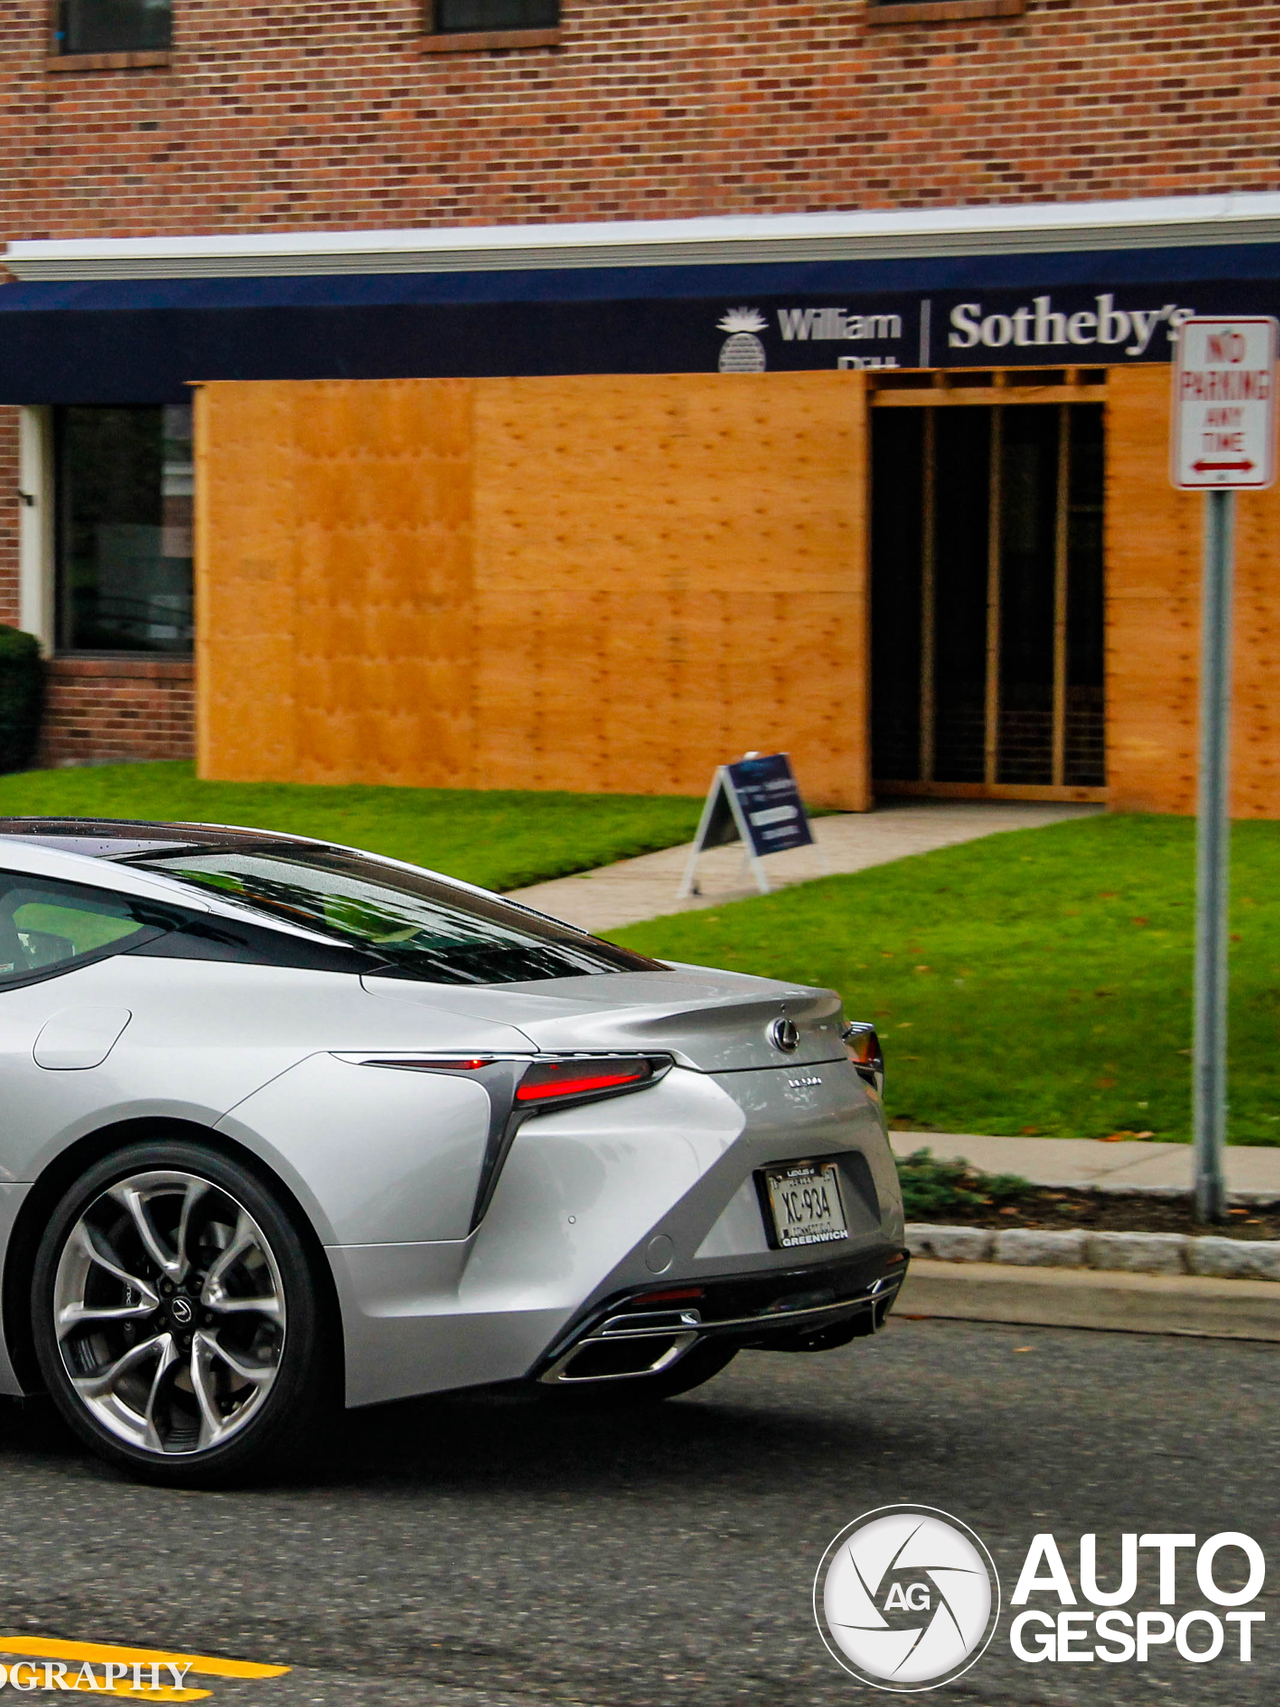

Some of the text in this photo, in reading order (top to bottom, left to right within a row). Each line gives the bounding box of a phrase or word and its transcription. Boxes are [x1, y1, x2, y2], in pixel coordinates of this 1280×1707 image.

[777, 307, 902, 341] William
[1204, 333, 1246, 363] NO
[1180, 370, 1269, 400] PARKING
[1204, 407, 1245, 427] ANY
[1202, 432, 1245, 452] TIME
[782, 1229, 849, 1247] GREENWICH
